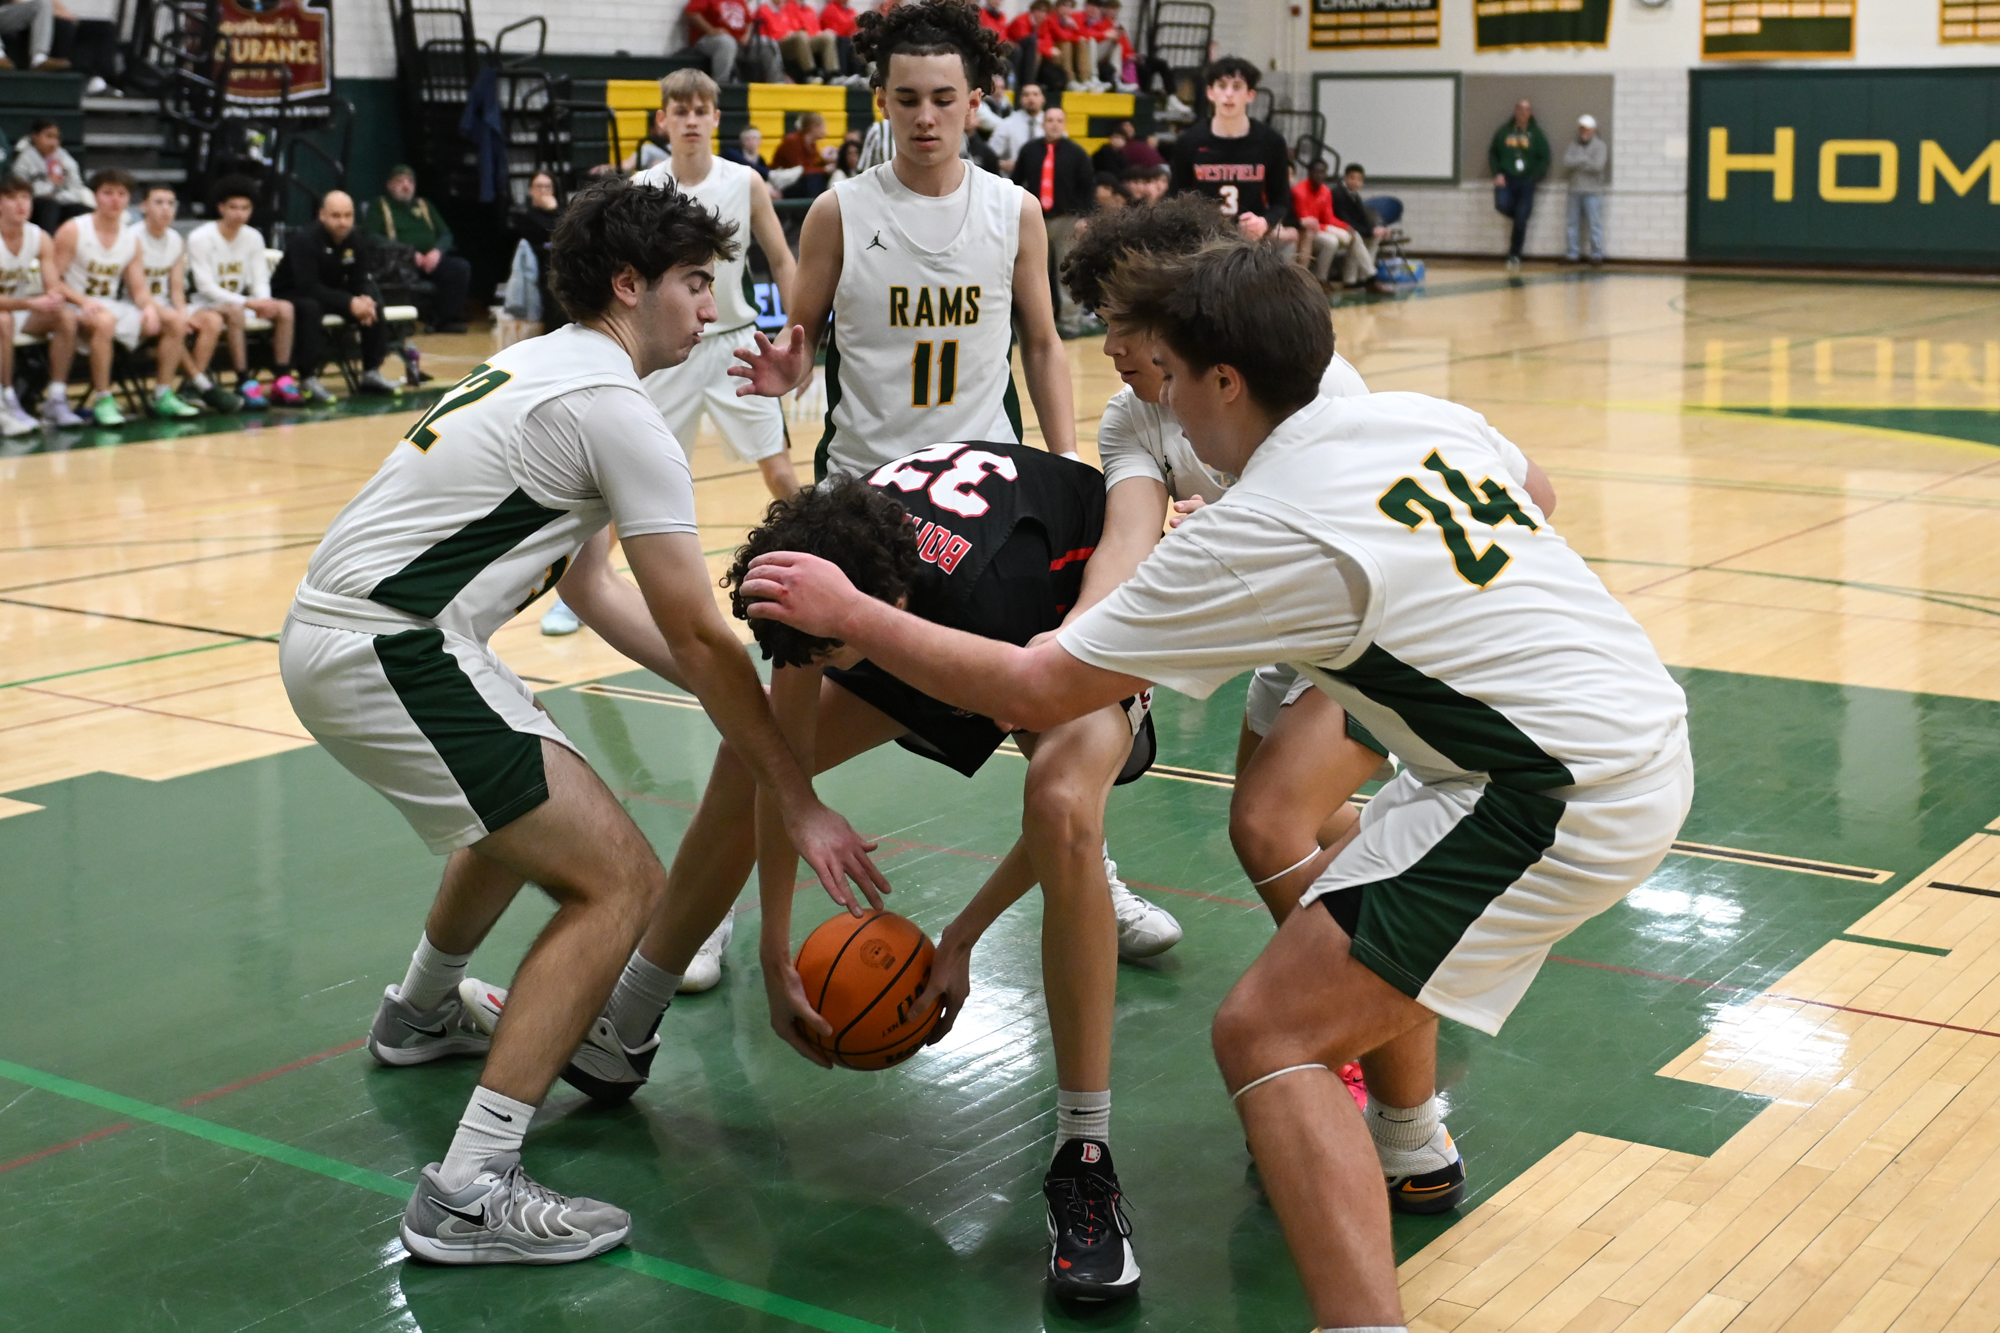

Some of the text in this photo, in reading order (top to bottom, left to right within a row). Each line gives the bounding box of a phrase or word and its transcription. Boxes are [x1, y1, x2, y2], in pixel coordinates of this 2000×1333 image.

[213, 37, 319, 64] URANCE
[1193, 163, 1266, 181] WESTFIELD
[1219, 184, 1239, 215] 3
[889, 285, 981, 327] RAMS
[911, 339, 959, 408] 11
[1375, 446, 1543, 592] 24
